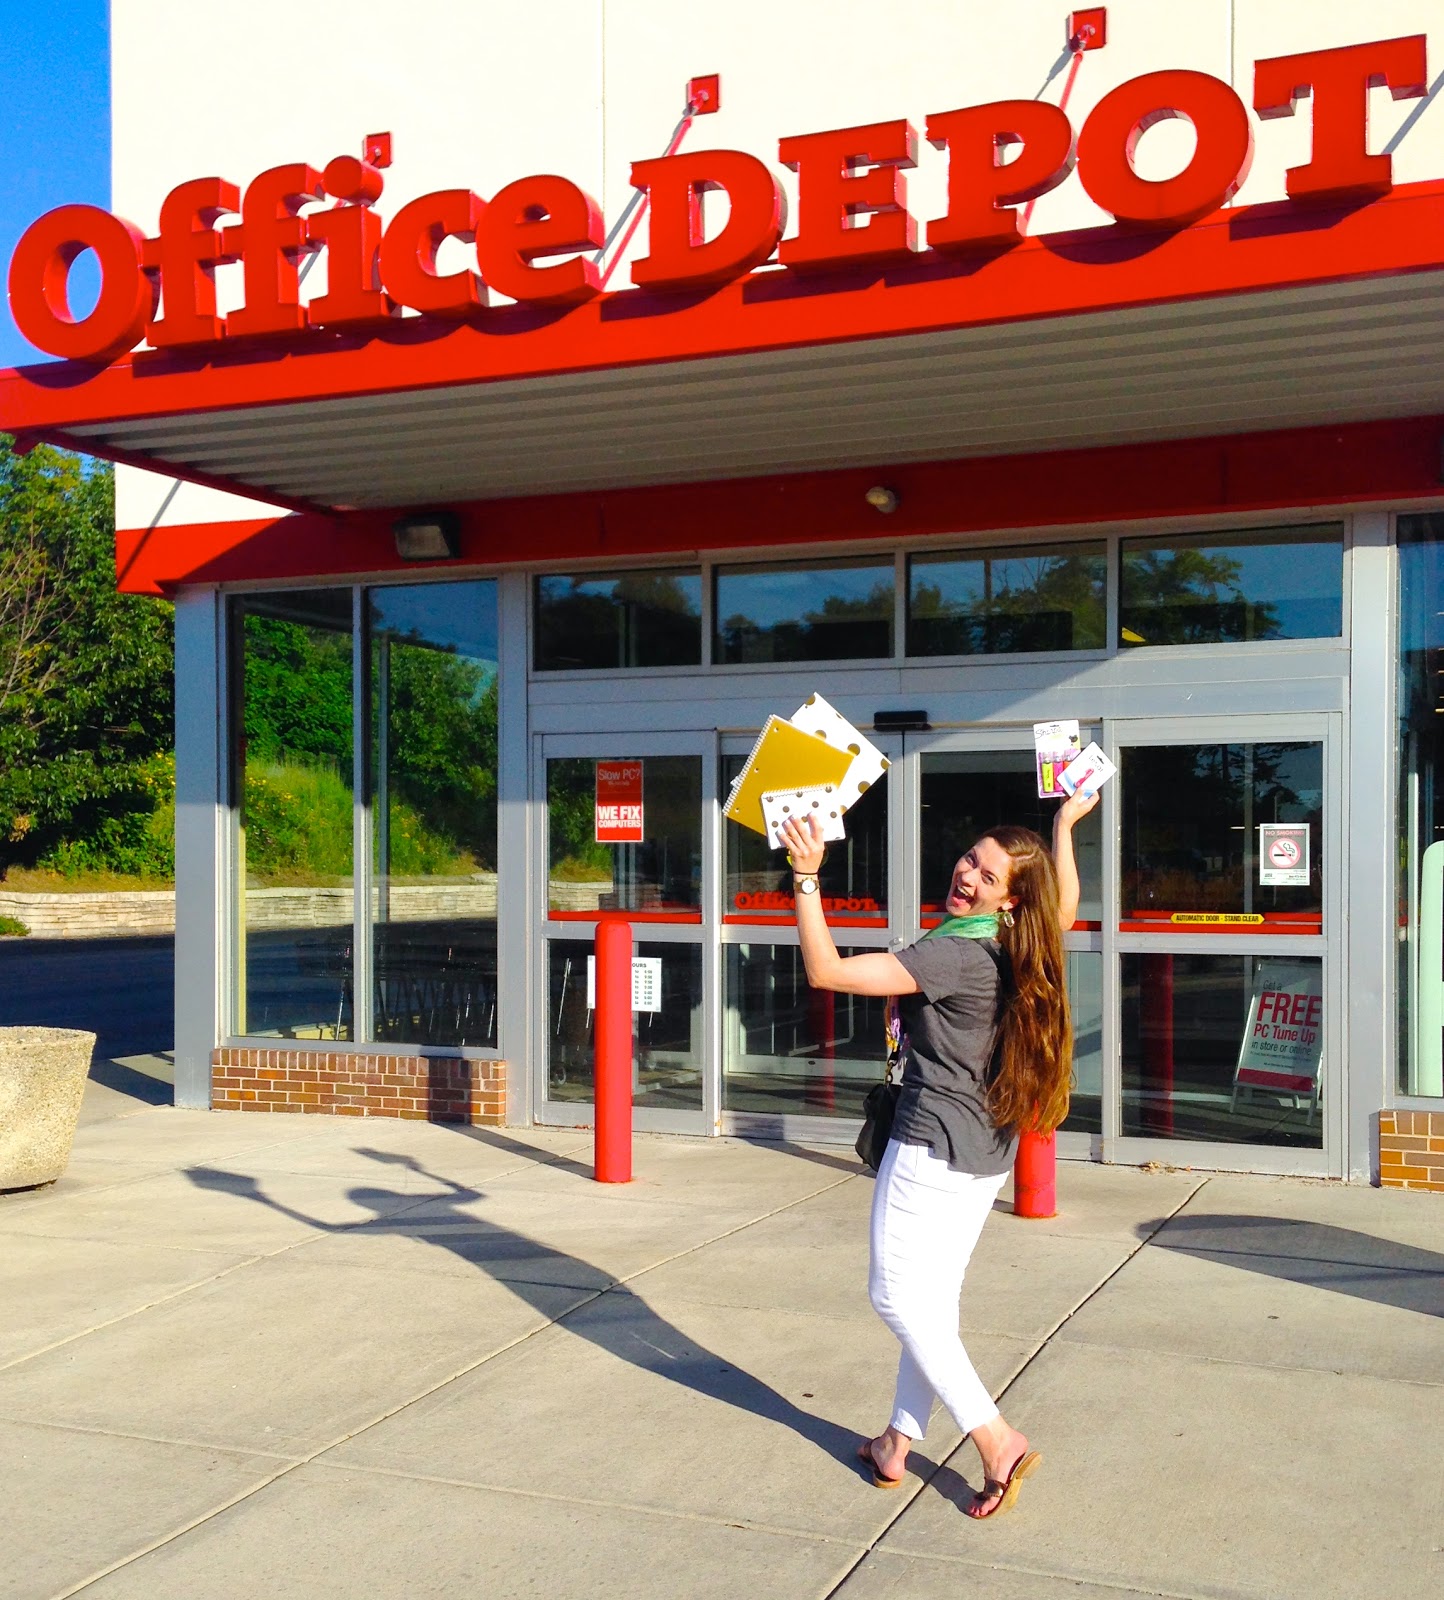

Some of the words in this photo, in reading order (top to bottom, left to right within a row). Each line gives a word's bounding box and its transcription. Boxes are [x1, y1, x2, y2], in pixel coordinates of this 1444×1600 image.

[8, 154, 606, 363] Office
[631, 34, 1427, 288] DEPOT
[598, 769, 620, 780] Slow
[623, 768, 640, 780] PC?
[598, 806, 618, 819] WE
[620, 806, 640, 819] FIX
[598, 820, 641, 828] COMPUTERS
[1176, 914, 1204, 922] AUTOMATIC
[1263, 980, 1276, 990] Get
[1257, 991, 1322, 1027] FREE
[1254, 1023, 1269, 1039] PC
[1272, 1025, 1297, 1042] Tune
[1301, 1027, 1316, 1046] Up
[1251, 1041, 1258, 1049] in
[1260, 1041, 1278, 1051] store
[1280, 1044, 1288, 1053] or
[1289, 1044, 1312, 1056] online
